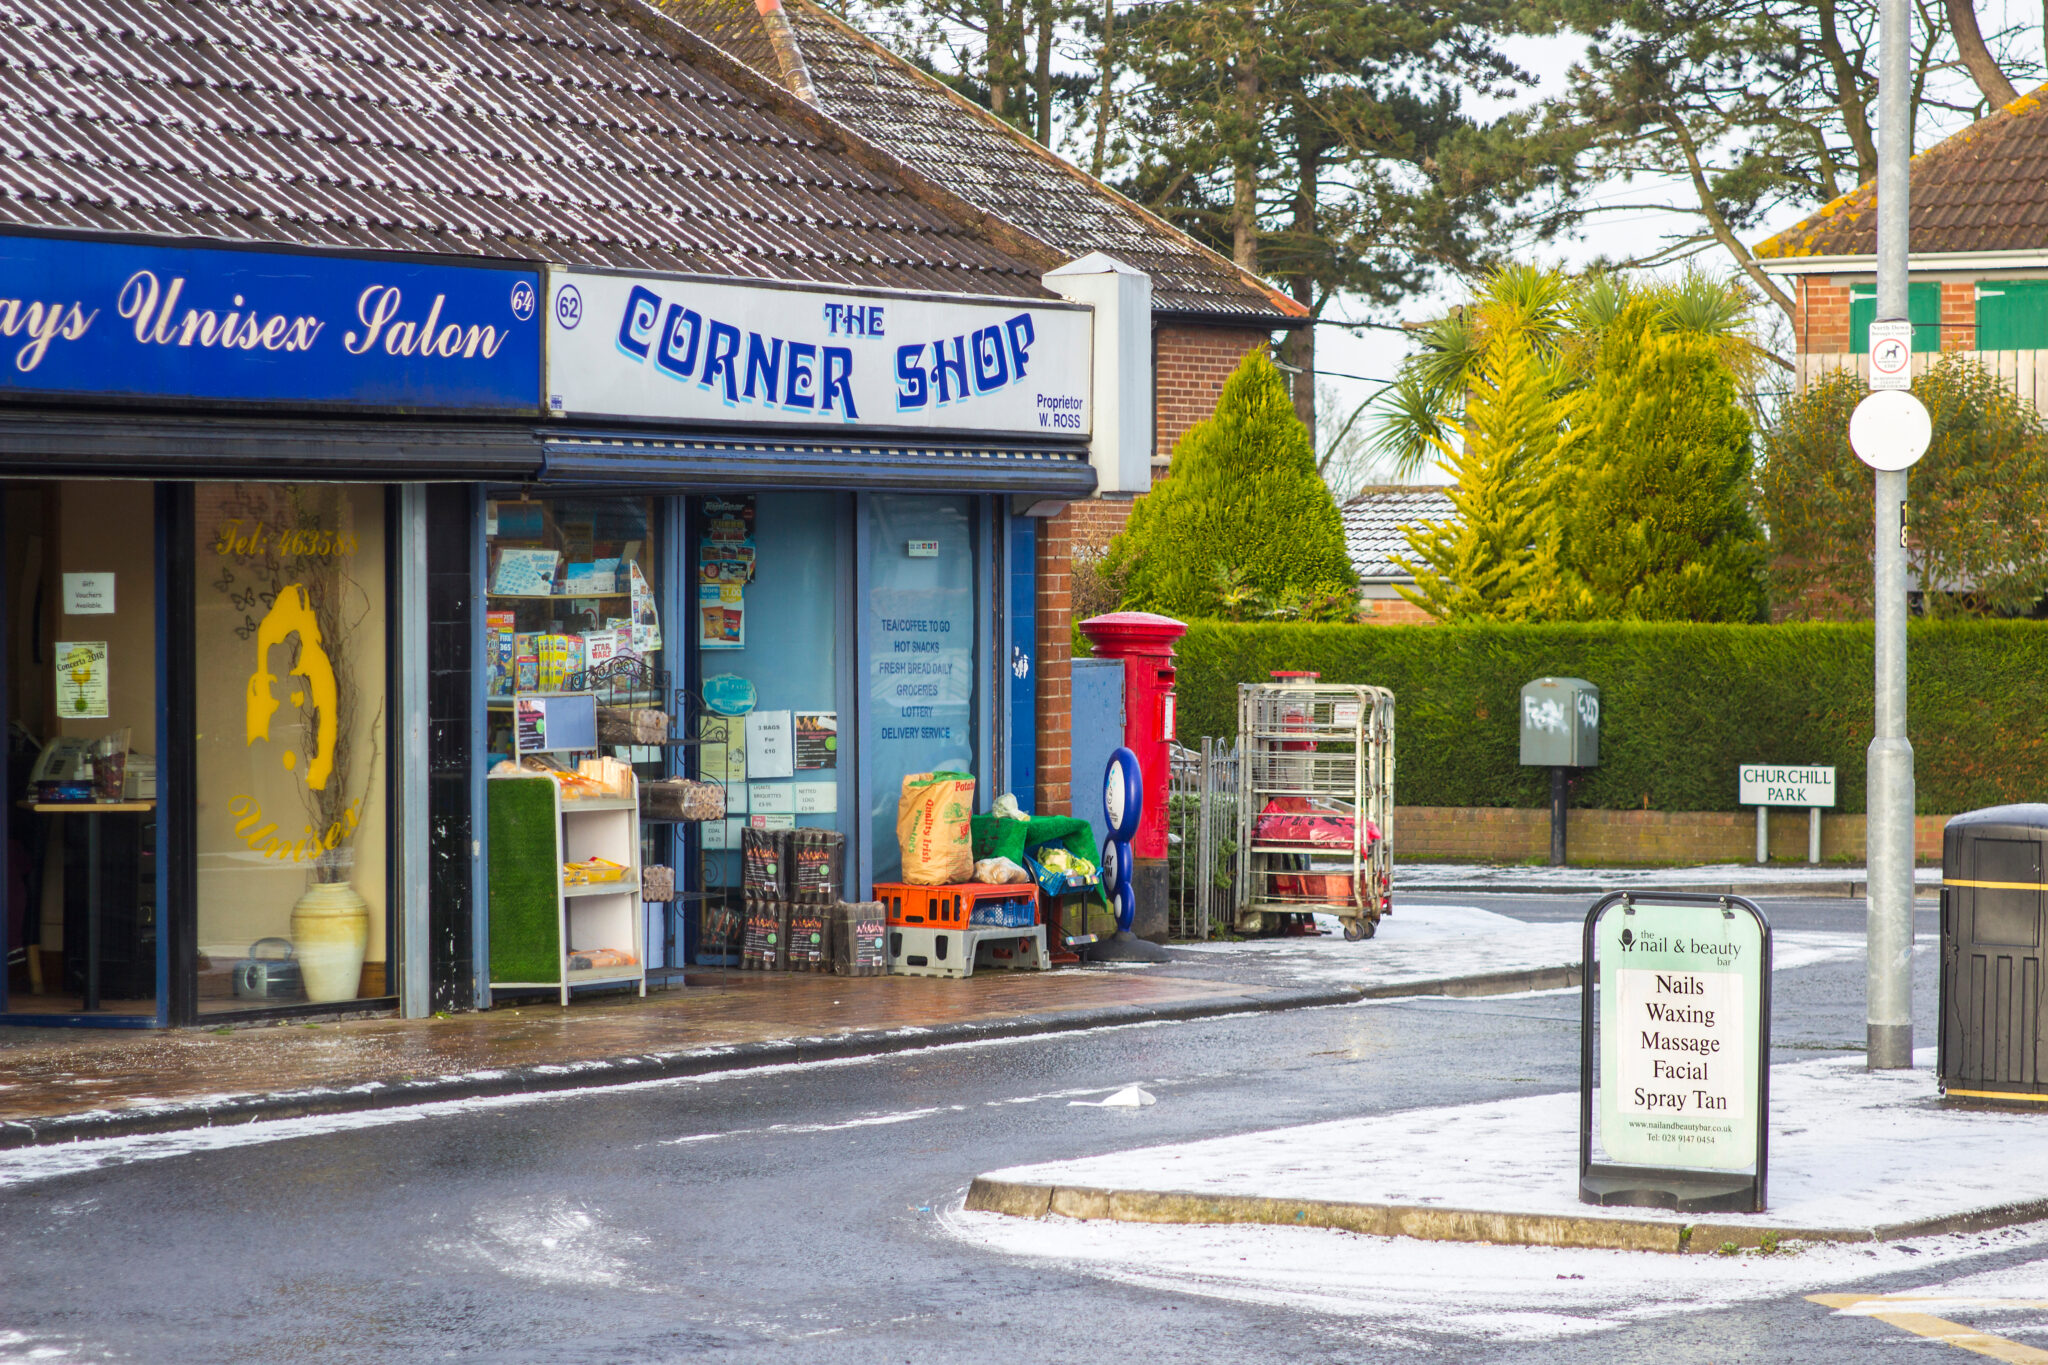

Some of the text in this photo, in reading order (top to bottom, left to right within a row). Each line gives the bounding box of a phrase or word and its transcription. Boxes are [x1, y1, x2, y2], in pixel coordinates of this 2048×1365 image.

[512, 290, 533, 312] 64
[558, 296, 579, 319] 62
[118, 270, 325, 352] Unisex
[344, 285, 509, 359] Salon
[823, 302, 885, 337] THE
[616, 285, 1036, 422] CORNER SHOP
[1036, 393, 1083, 413] Proprietor
[1038, 412, 1081, 429] W. ROSS
[216, 518, 361, 557] Tel: 463588
[881, 619, 950, 633] TEA/COFFEE TO GO
[591, 643, 612, 652] STAR
[591, 651, 612, 660] WARS
[894, 641, 940, 654] HOT SNACKS
[56, 650, 105, 672] Concerts 2018
[879, 662, 953, 676] FRESH BREAD DAILY
[896, 684, 938, 697] GROCERIES
[901, 706, 934, 718] LOTTERY
[881, 727, 950, 740] DELIVERY SERVICE
[1743, 768, 1831, 785] CHURCHILL
[1767, 787, 1807, 802] PARK
[228, 794, 363, 863] Unisex
[922, 798, 934, 863] Quality Irish
[1641, 929, 1655, 940] the
[1640, 937, 1742, 960] nail & beauty
[1717, 957, 1732, 967] bar
[1655, 975, 1704, 996] Nails
[1645, 1002, 1715, 1028] Waxing
[1641, 1031, 1720, 1056] Massage
[1653, 1060, 1709, 1081] Facial
[1634, 1087, 1728, 1112] Spray Tan
[1628, 1120, 1733, 1133] www.nailandbeautybar.co.uk
[1647, 1133, 1716, 1144] Tel: 028 9147 0454
